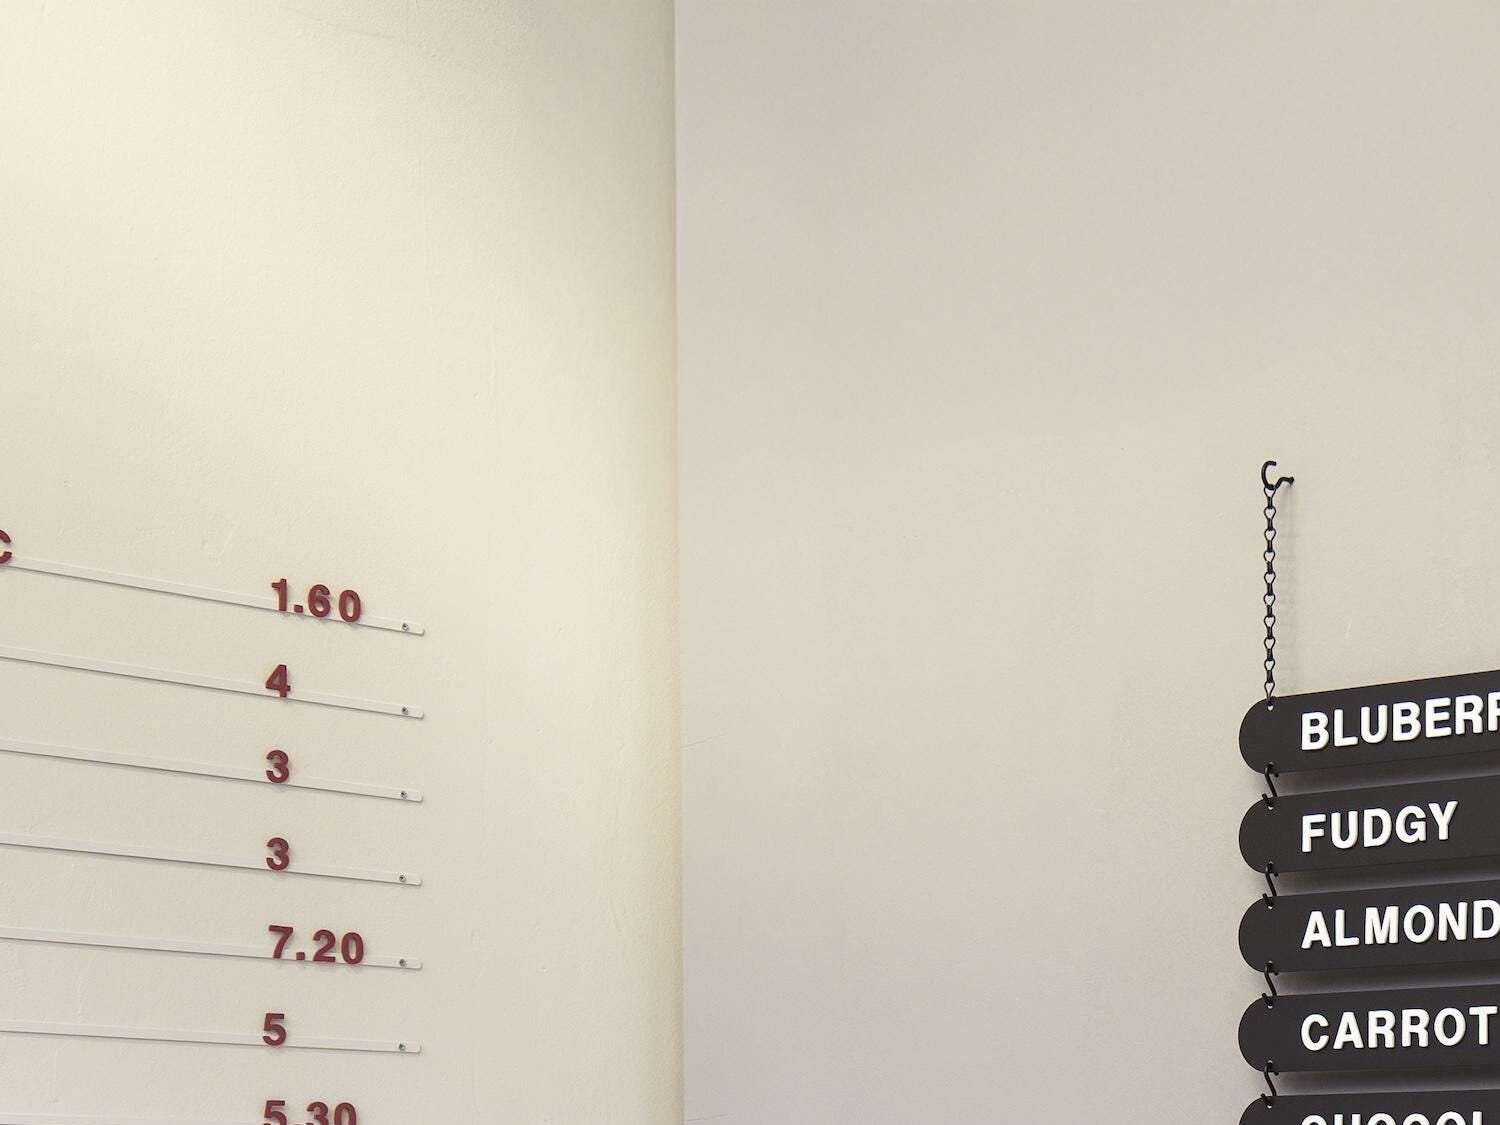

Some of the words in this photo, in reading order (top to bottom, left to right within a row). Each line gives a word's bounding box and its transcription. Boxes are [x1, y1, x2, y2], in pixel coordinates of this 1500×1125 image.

[272, 578, 362, 622] 1.60
[265, 664, 291, 698] 4
[265, 749, 290, 784] 3
[1301, 800, 1458, 853] FUDGY
[265, 836, 290, 871] 3
[268, 925, 364, 965] 7.20
[262, 1012, 287, 1046] 5
[1301, 1005, 1498, 1051] CARROT
